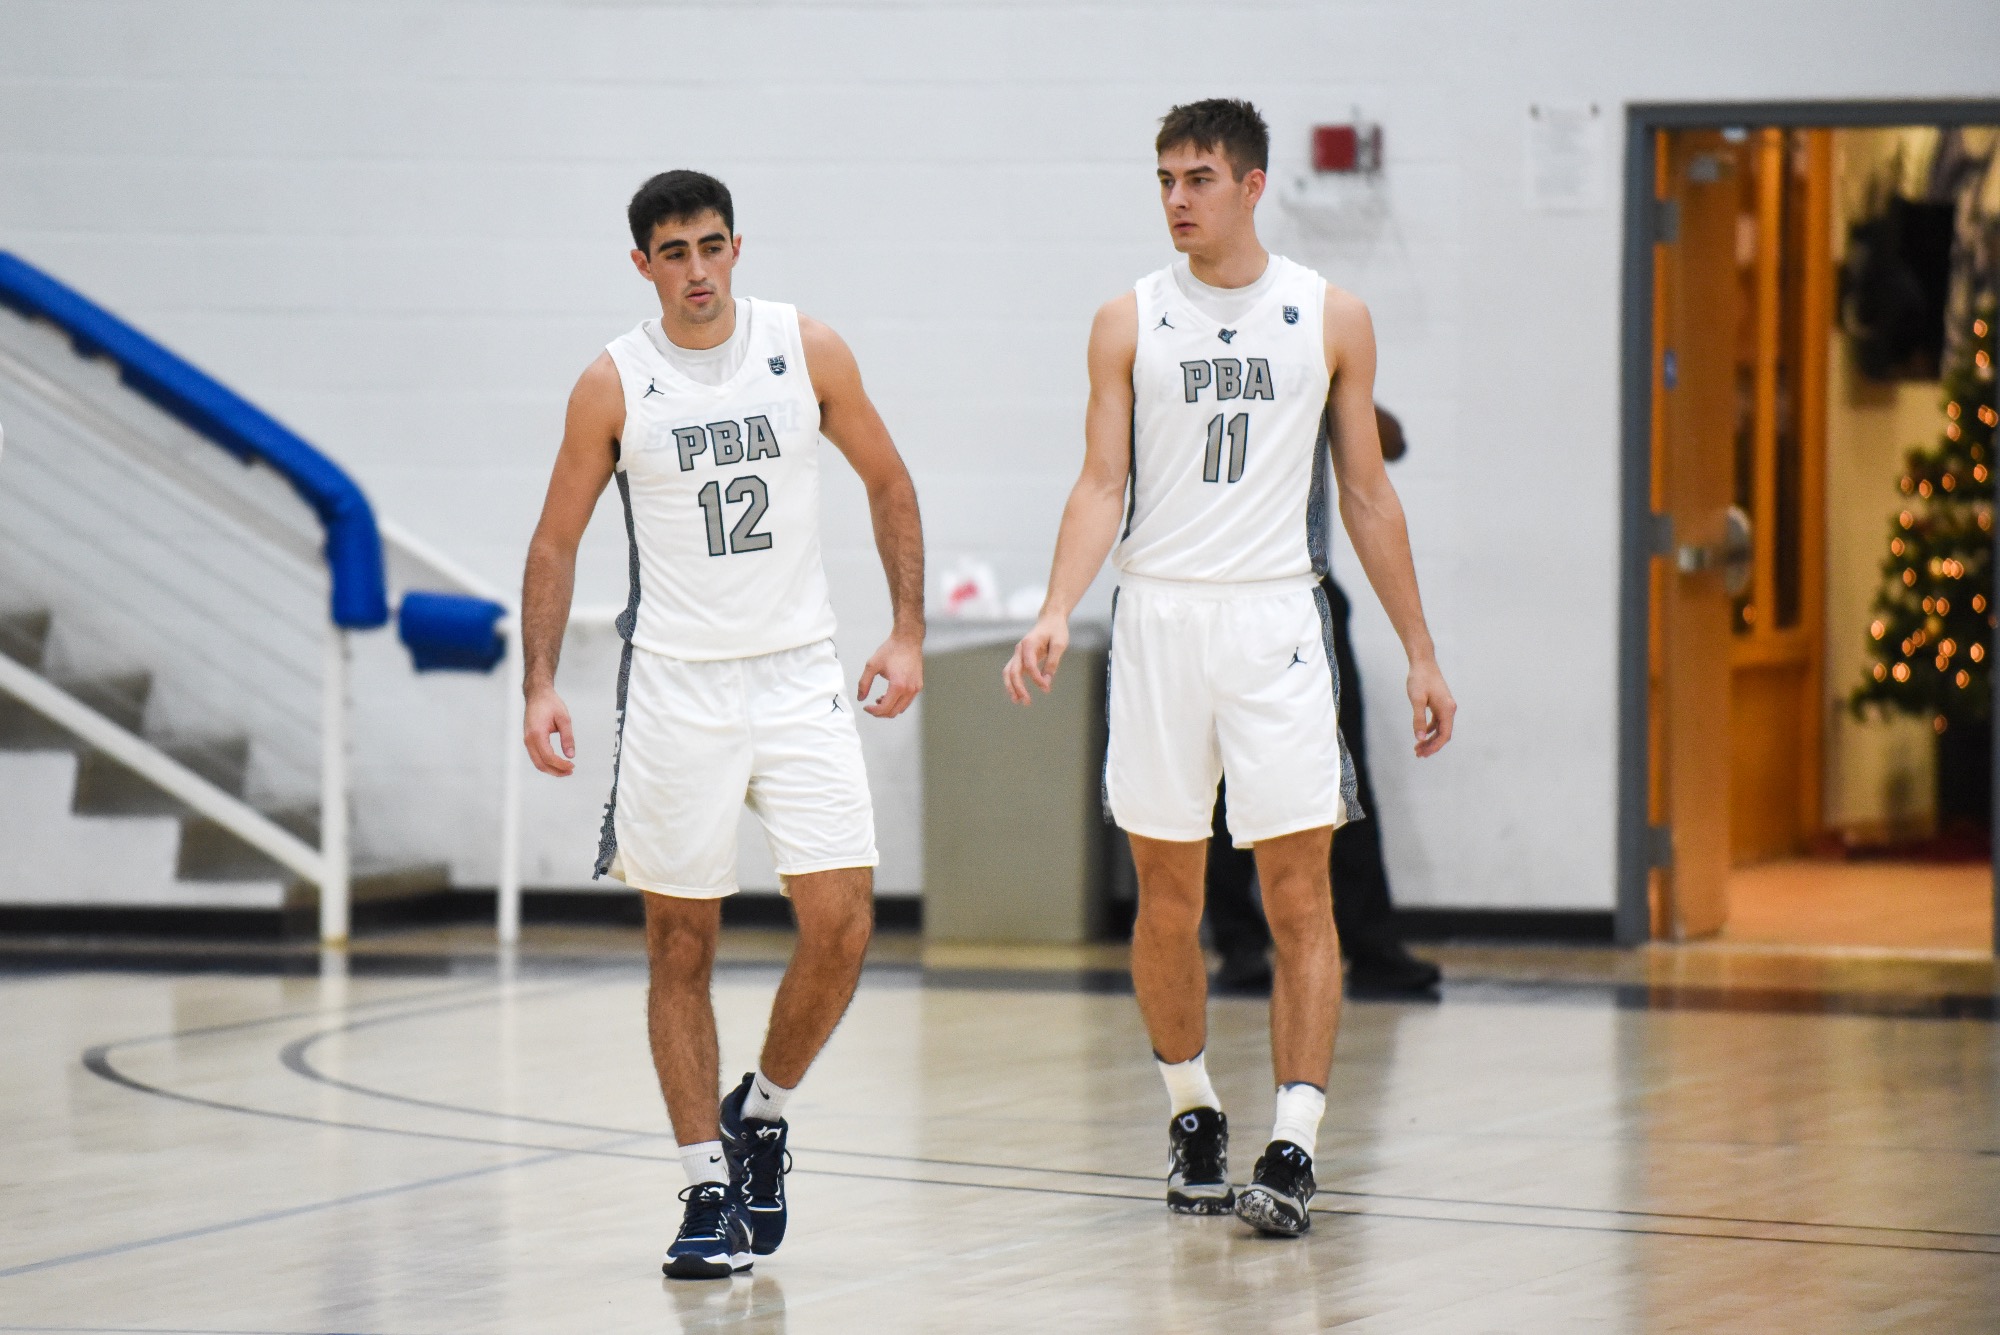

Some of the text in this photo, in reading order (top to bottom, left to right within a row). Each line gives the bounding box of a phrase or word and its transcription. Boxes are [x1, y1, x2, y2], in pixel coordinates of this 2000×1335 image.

[1180, 358, 1274, 403] PBA
[672, 415, 780, 471] PBA
[1203, 413, 1249, 483] 11
[698, 475, 772, 556] 12
